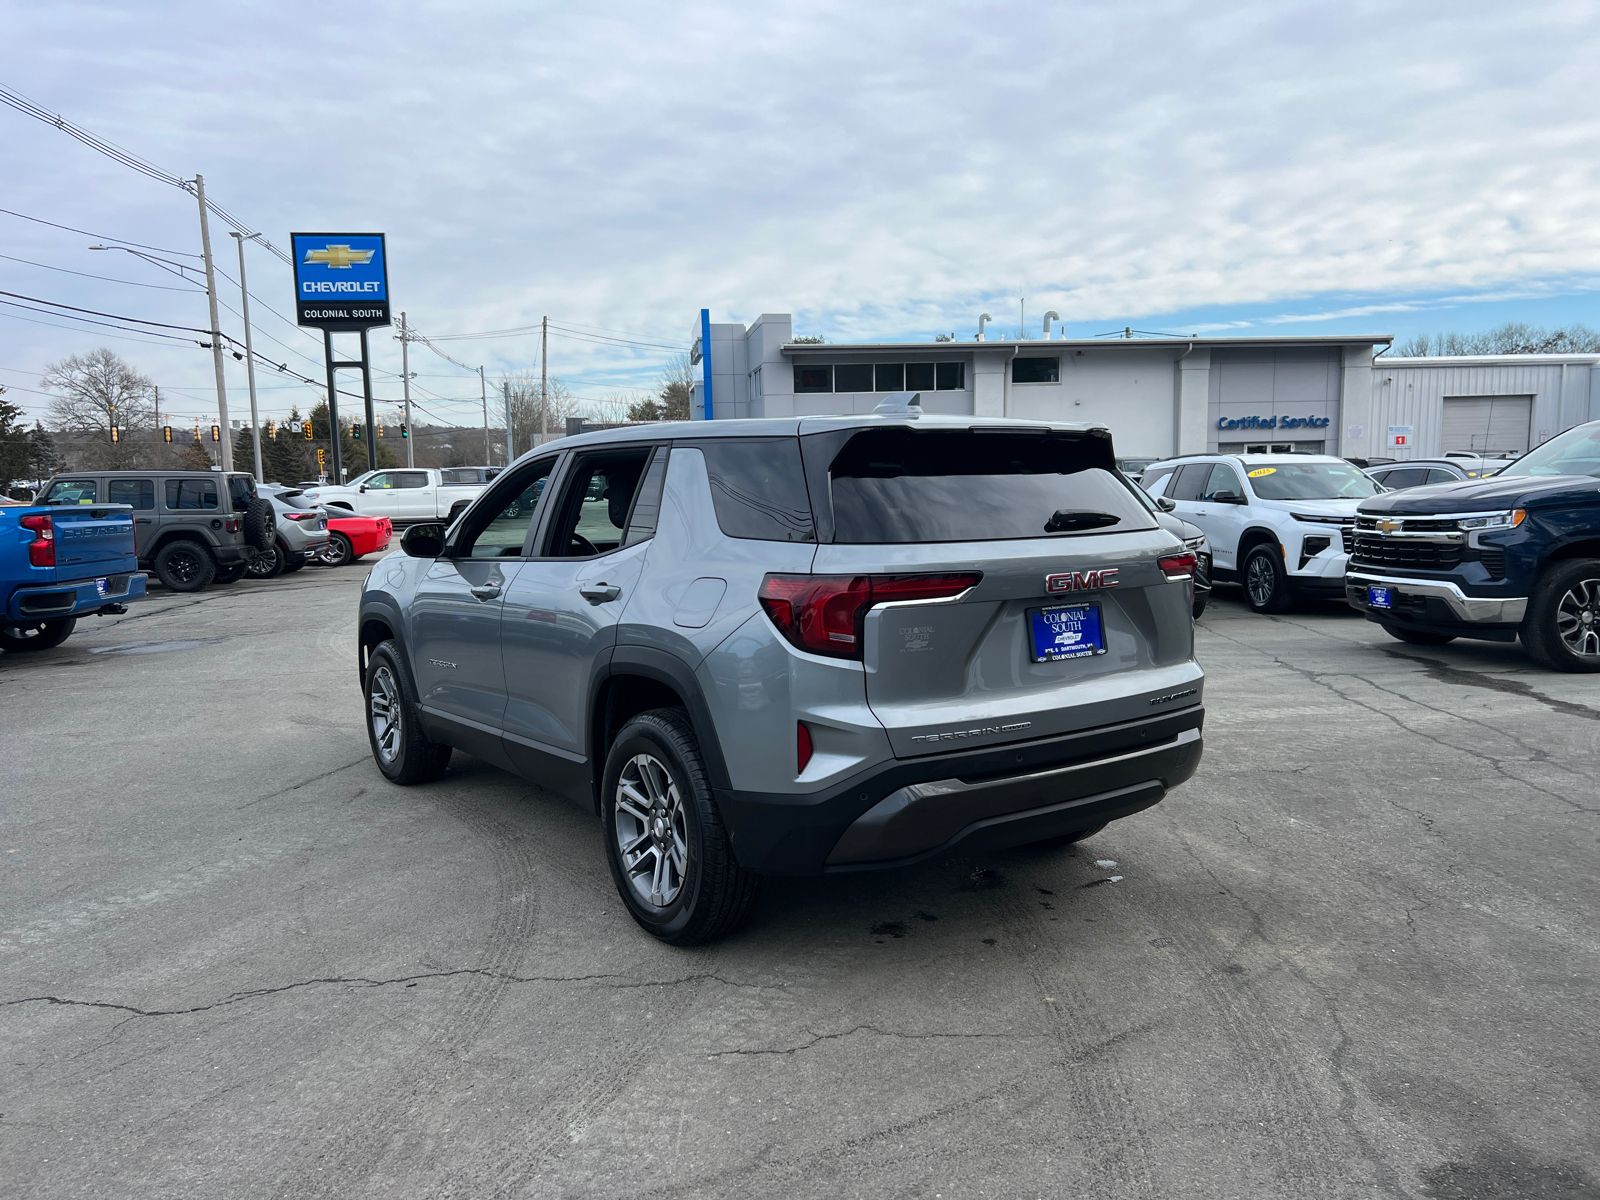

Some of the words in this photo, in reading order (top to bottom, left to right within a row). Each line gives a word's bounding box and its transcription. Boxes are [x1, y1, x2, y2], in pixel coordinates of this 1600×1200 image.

[303, 281, 380, 293] CHEVROLET
[304, 309, 350, 318] COLONIAL
[352, 309, 383, 318] SOUTH
[1218, 415, 1277, 429] Certified
[1281, 414, 1330, 428] Service
[1253, 468, 1271, 477] 2025
[63, 526, 133, 539] CHEVROLET
[1045, 568, 1119, 594] GMC
[1044, 611, 1086, 624] COLONIAL
[1052, 621, 1081, 633] SOUTH
[911, 726, 999, 743] TERRAIN
